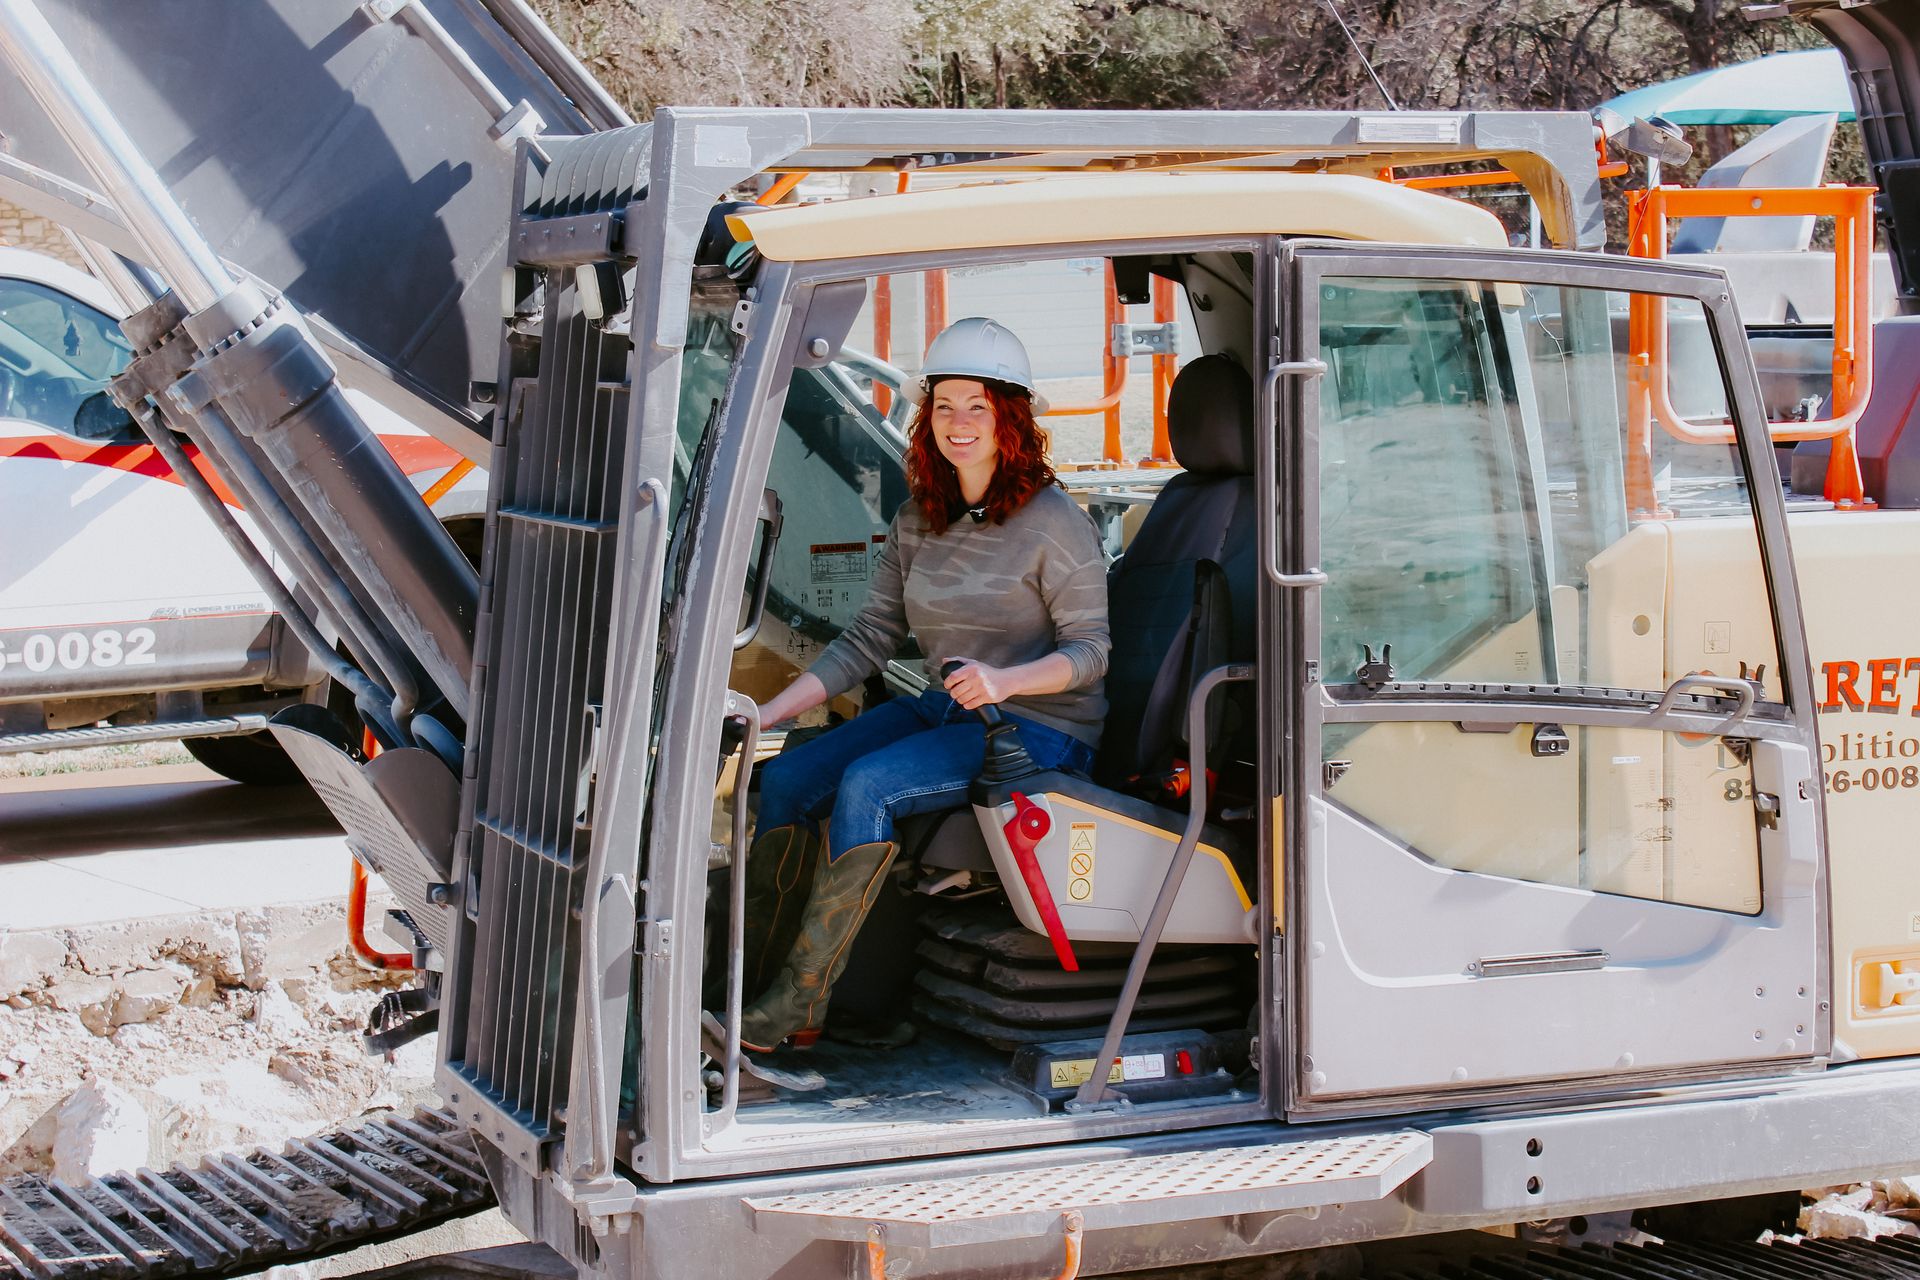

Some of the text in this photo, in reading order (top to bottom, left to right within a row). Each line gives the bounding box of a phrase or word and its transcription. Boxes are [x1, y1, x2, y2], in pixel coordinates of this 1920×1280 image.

[224, 603, 263, 611] STROKE
[0, 627, 156, 672] -0082
[1825, 765, 1920, 794] 6-008
